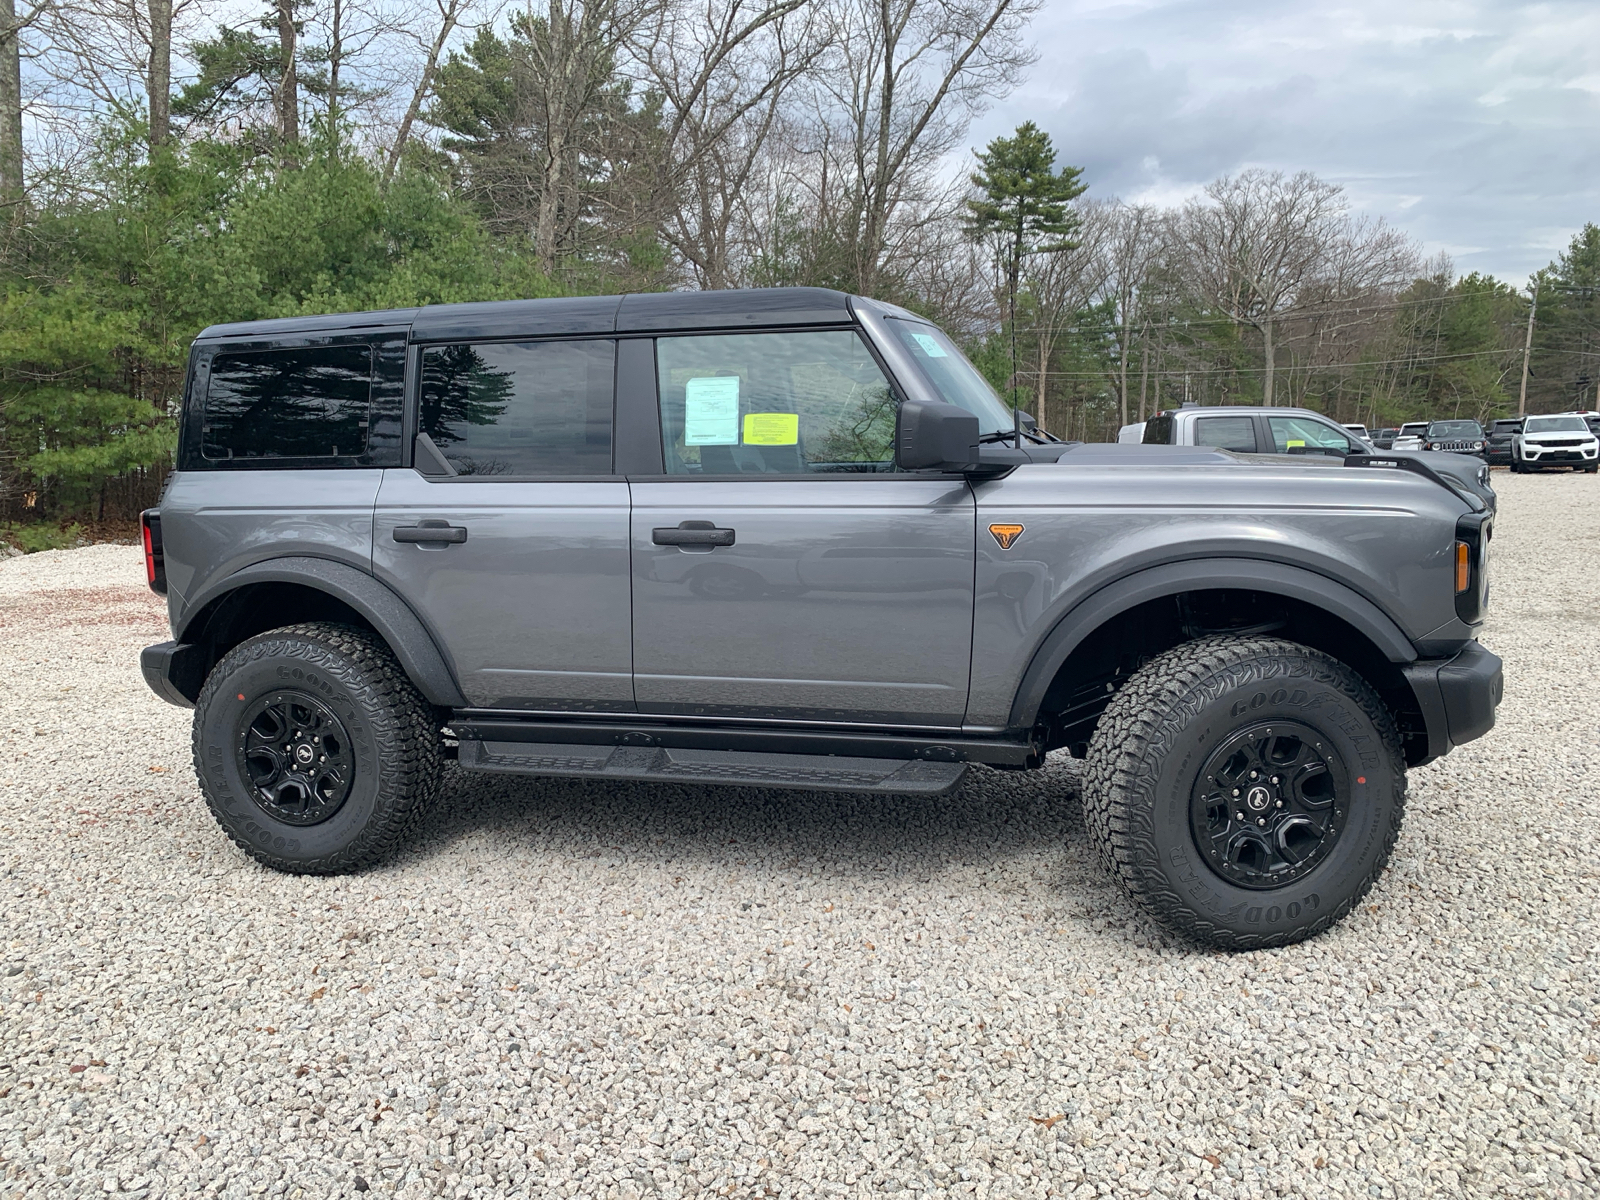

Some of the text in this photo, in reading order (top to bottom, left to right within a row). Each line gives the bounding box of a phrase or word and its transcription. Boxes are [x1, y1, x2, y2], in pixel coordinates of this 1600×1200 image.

[276, 665, 373, 776] GOODYEAR
[1229, 688, 1382, 771] GOODYEAR
[208, 745, 300, 853] GOODYEAR
[1169, 844, 1321, 925] GOODYEAR
